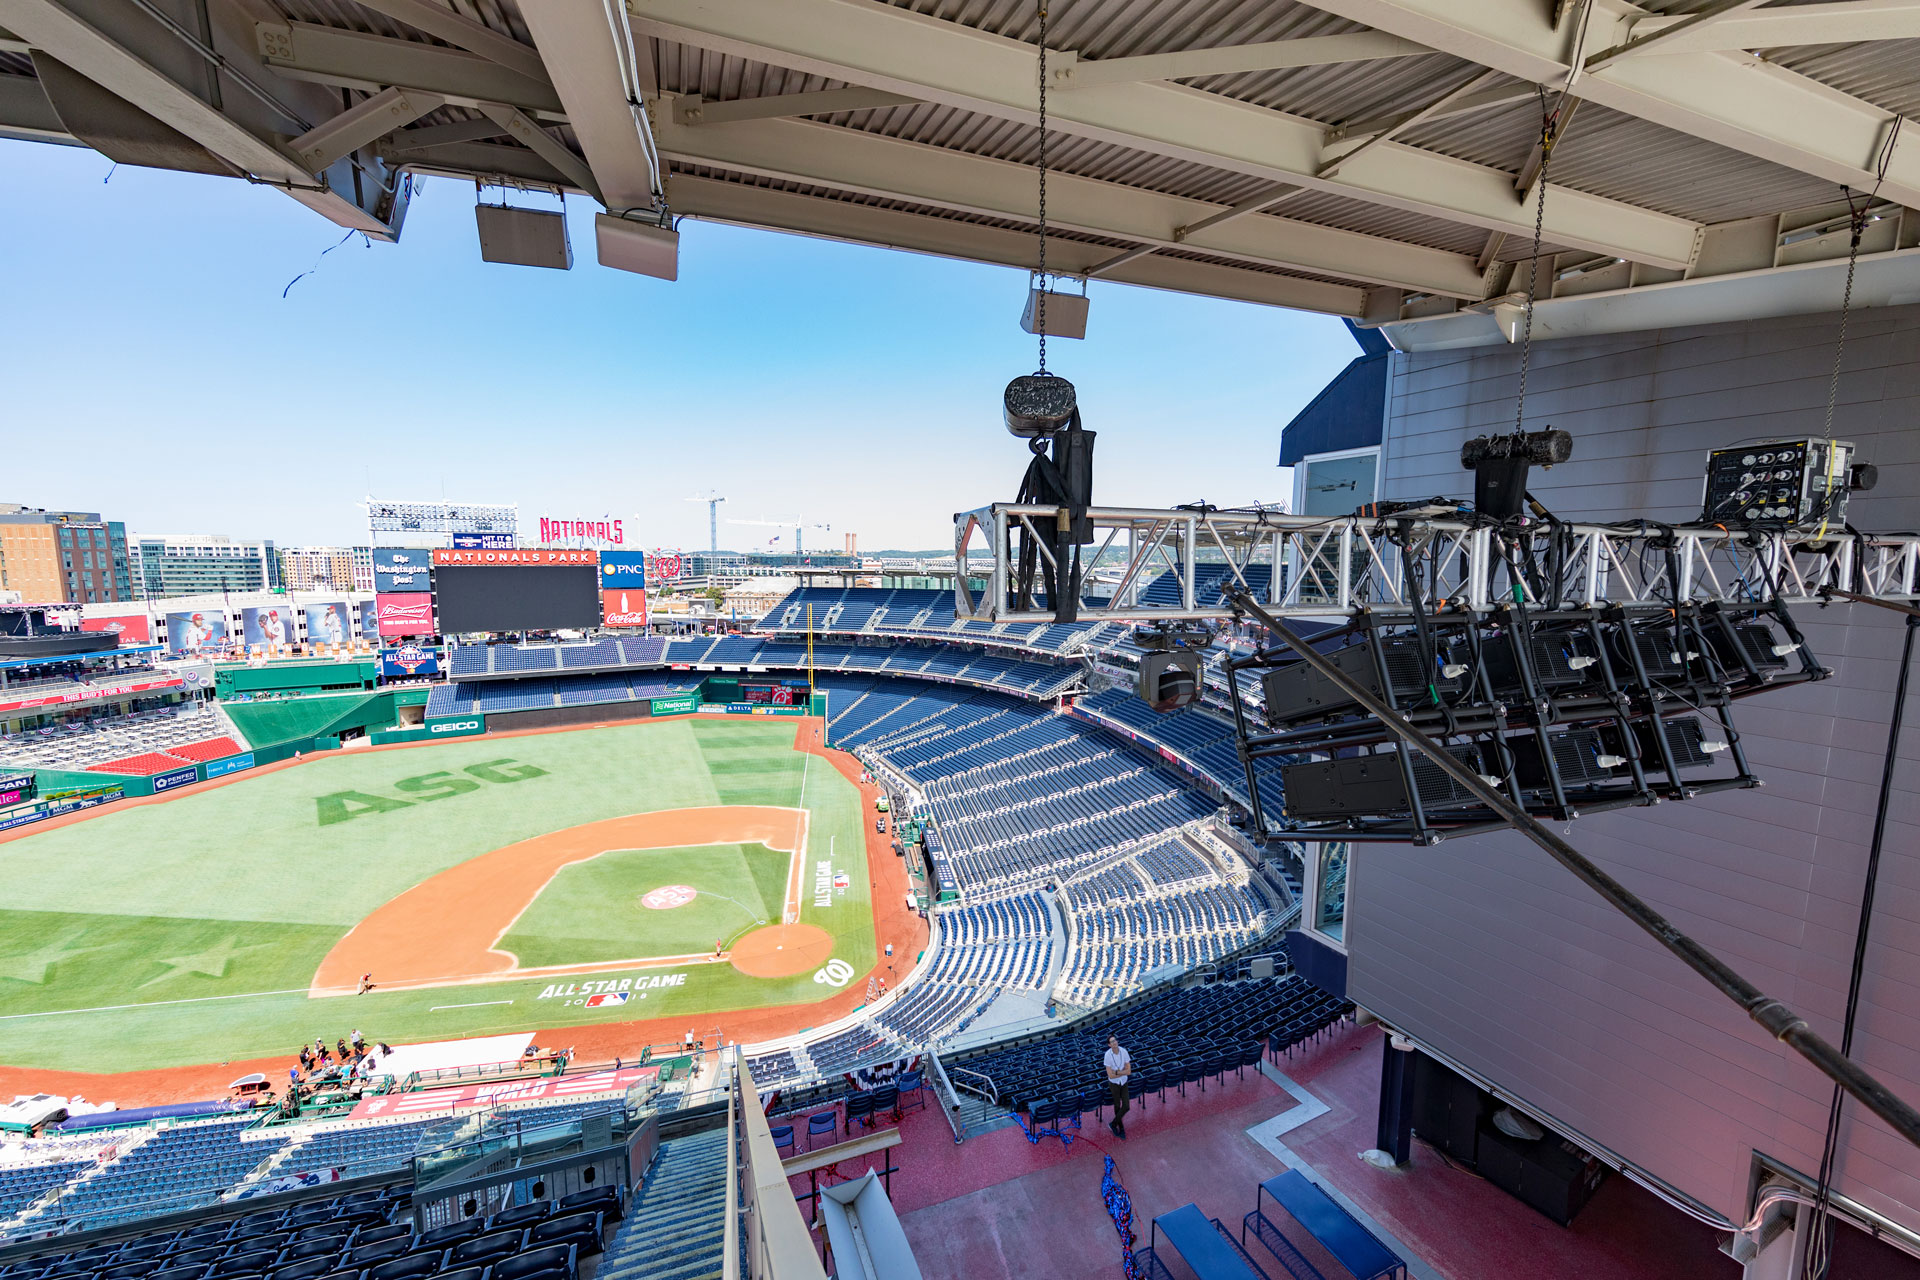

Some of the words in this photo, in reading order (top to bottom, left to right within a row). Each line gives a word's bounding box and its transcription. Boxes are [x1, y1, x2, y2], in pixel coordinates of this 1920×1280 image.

[540, 517, 623, 544] NATIONALS
[482, 541, 512, 549] HERE
[392, 554, 409, 564] The
[440, 553, 540, 562] NATIONALS
[549, 553, 589, 562] PARK
[376, 563, 428, 575] Washington
[616, 565, 643, 574] PNC
[392, 575, 414, 586] Post
[606, 612, 644, 624] Coca-Cola
[63, 694, 80, 702] THIS
[104, 686, 118, 696] FOR
[664, 700, 692, 709] National
[431, 721, 479, 733] GEICO
[168, 771, 195, 783] PENFED
[312, 758, 552, 826] ASG
[53, 803, 73, 814] MGM
[648, 886, 691, 907] ASG
[634, 973, 688, 990] GAME
[473, 1080, 549, 1104] WORLD
